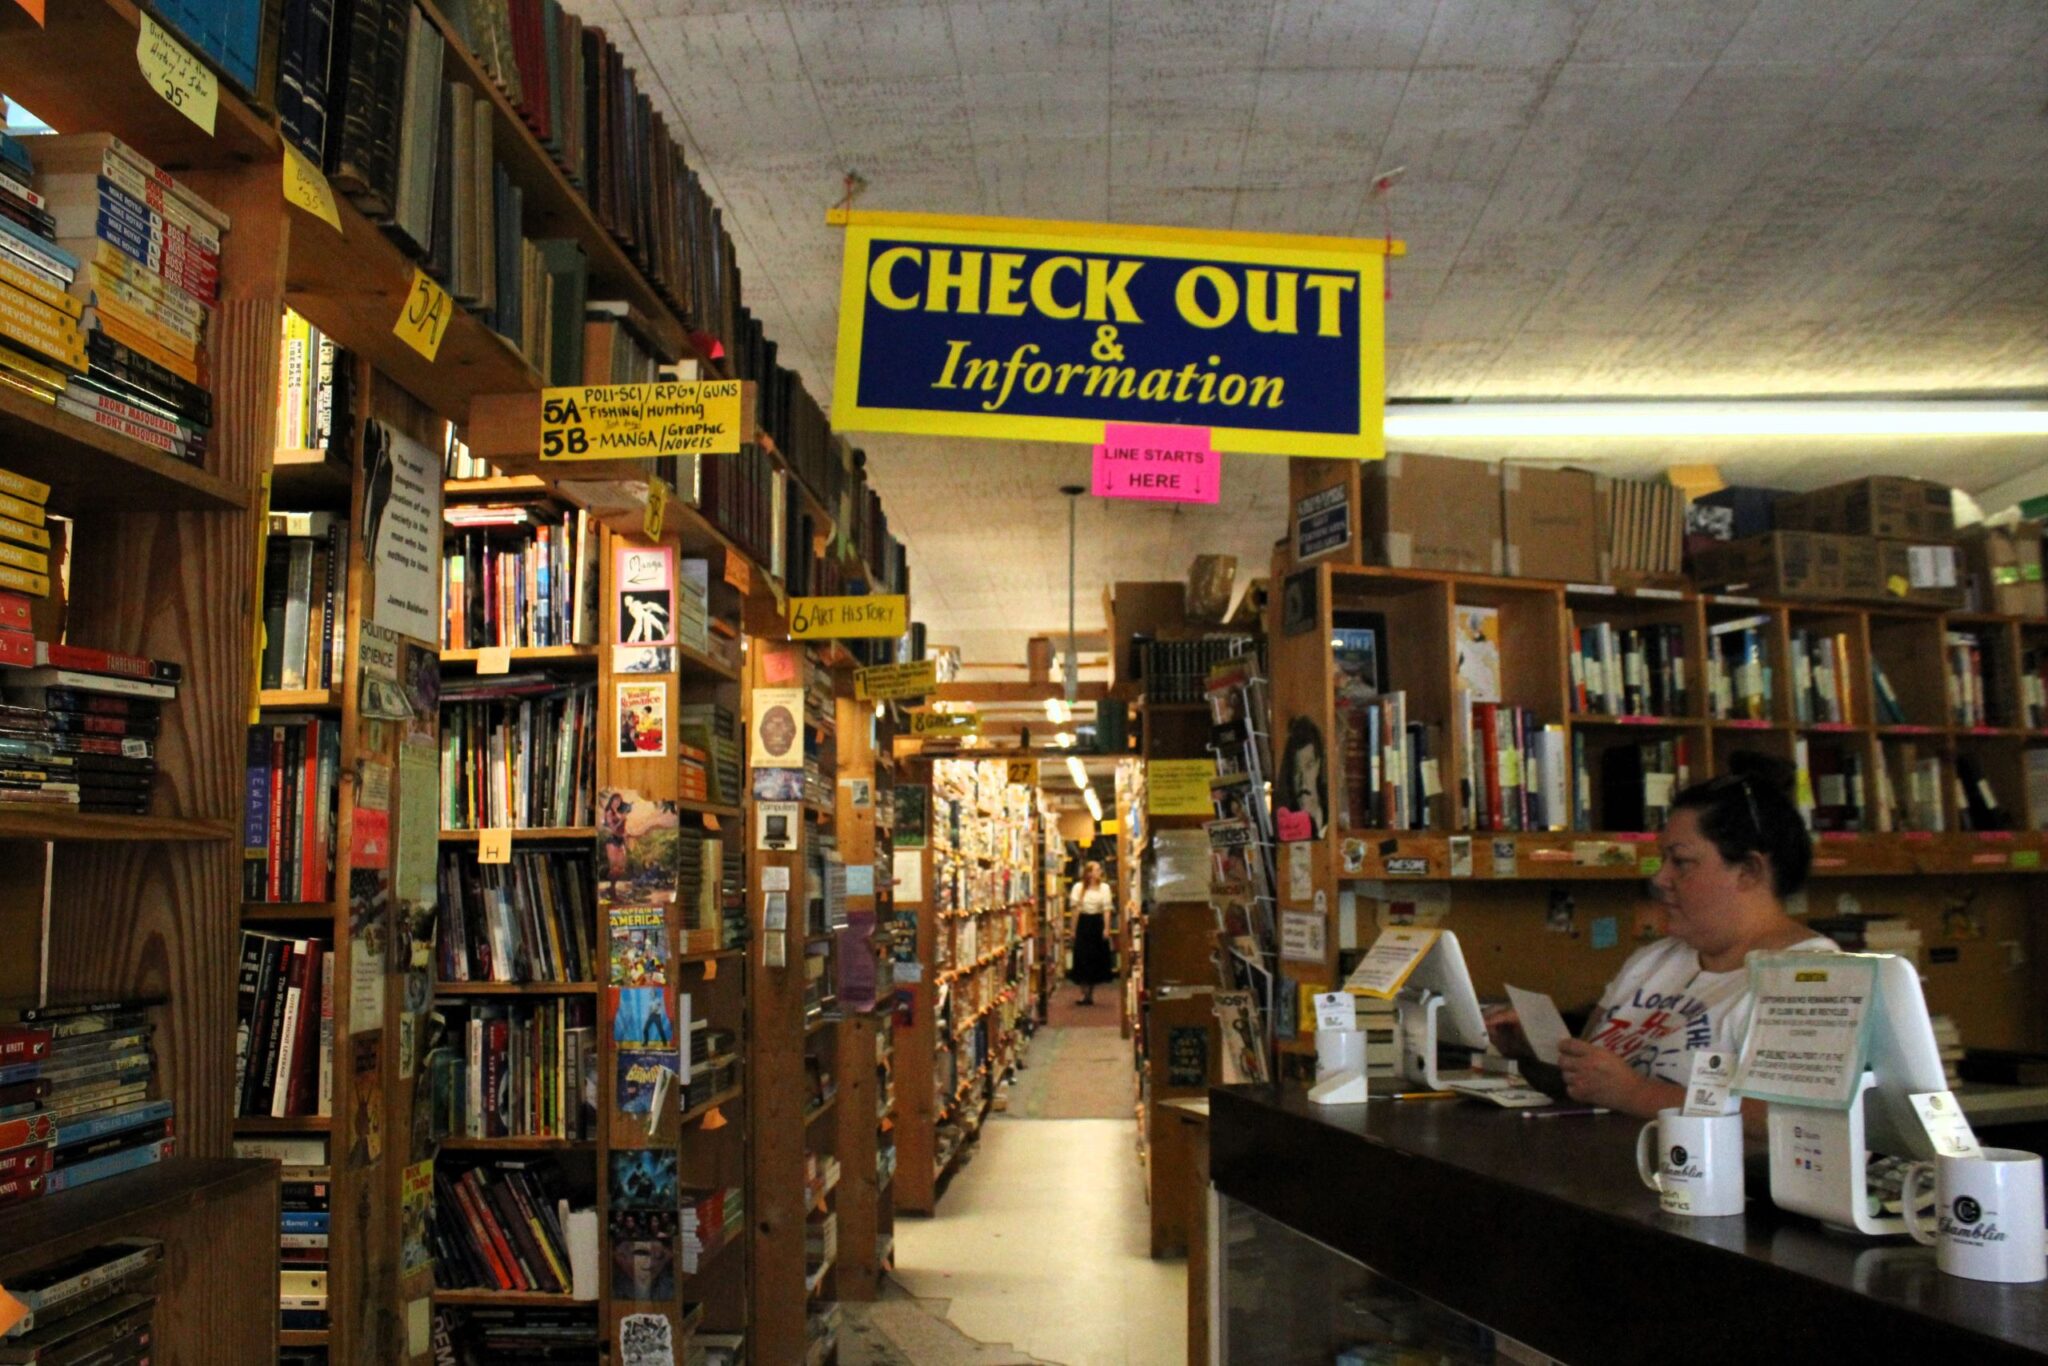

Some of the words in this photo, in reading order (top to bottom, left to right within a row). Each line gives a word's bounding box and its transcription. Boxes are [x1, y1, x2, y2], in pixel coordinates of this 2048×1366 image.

[109, 186, 123, 201] MIKE
[167, 224, 186, 245] BOSS
[110, 202, 124, 217] MIKE
[168, 240, 186, 261] BOSS
[106, 230, 121, 246] MIKE
[164, 266, 183, 288] BOSS
[108, 217, 123, 233] MIKE
[165, 254, 184, 274] BOSS
[868, 246, 1145, 324] CHECK
[1174, 264, 1356, 338] OUT
[409, 279, 444, 345] 5A
[5, 322, 41, 347] TREVOR
[41, 340, 66, 358] NOAH
[1090, 323, 1126, 363] &
[930, 339, 1286, 411] Information
[95, 410, 123, 432] BRONX
[124, 421, 173, 450] MASQUERADE
[99, 394, 126, 416] BRONX
[128, 406, 178, 435] MASQUERADE
[1104, 448, 1139, 461] LINE
[1144, 449, 1205, 465] STARTS
[1129, 473, 1181, 489] HERE
[387, 549, 410, 568] nothing
[387, 594, 406, 610] James
[406, 599, 429, 617] Baldwin
[793, 603, 809, 633] 6
[810, 604, 835, 627] ART
[107, 655, 147, 678] FAHRENHEIT
[360, 644, 394, 668] SCIENCE
[1010, 763, 1032, 783] 27
[486, 846, 500, 860] H
[610, 913, 659, 927] AMERICA
